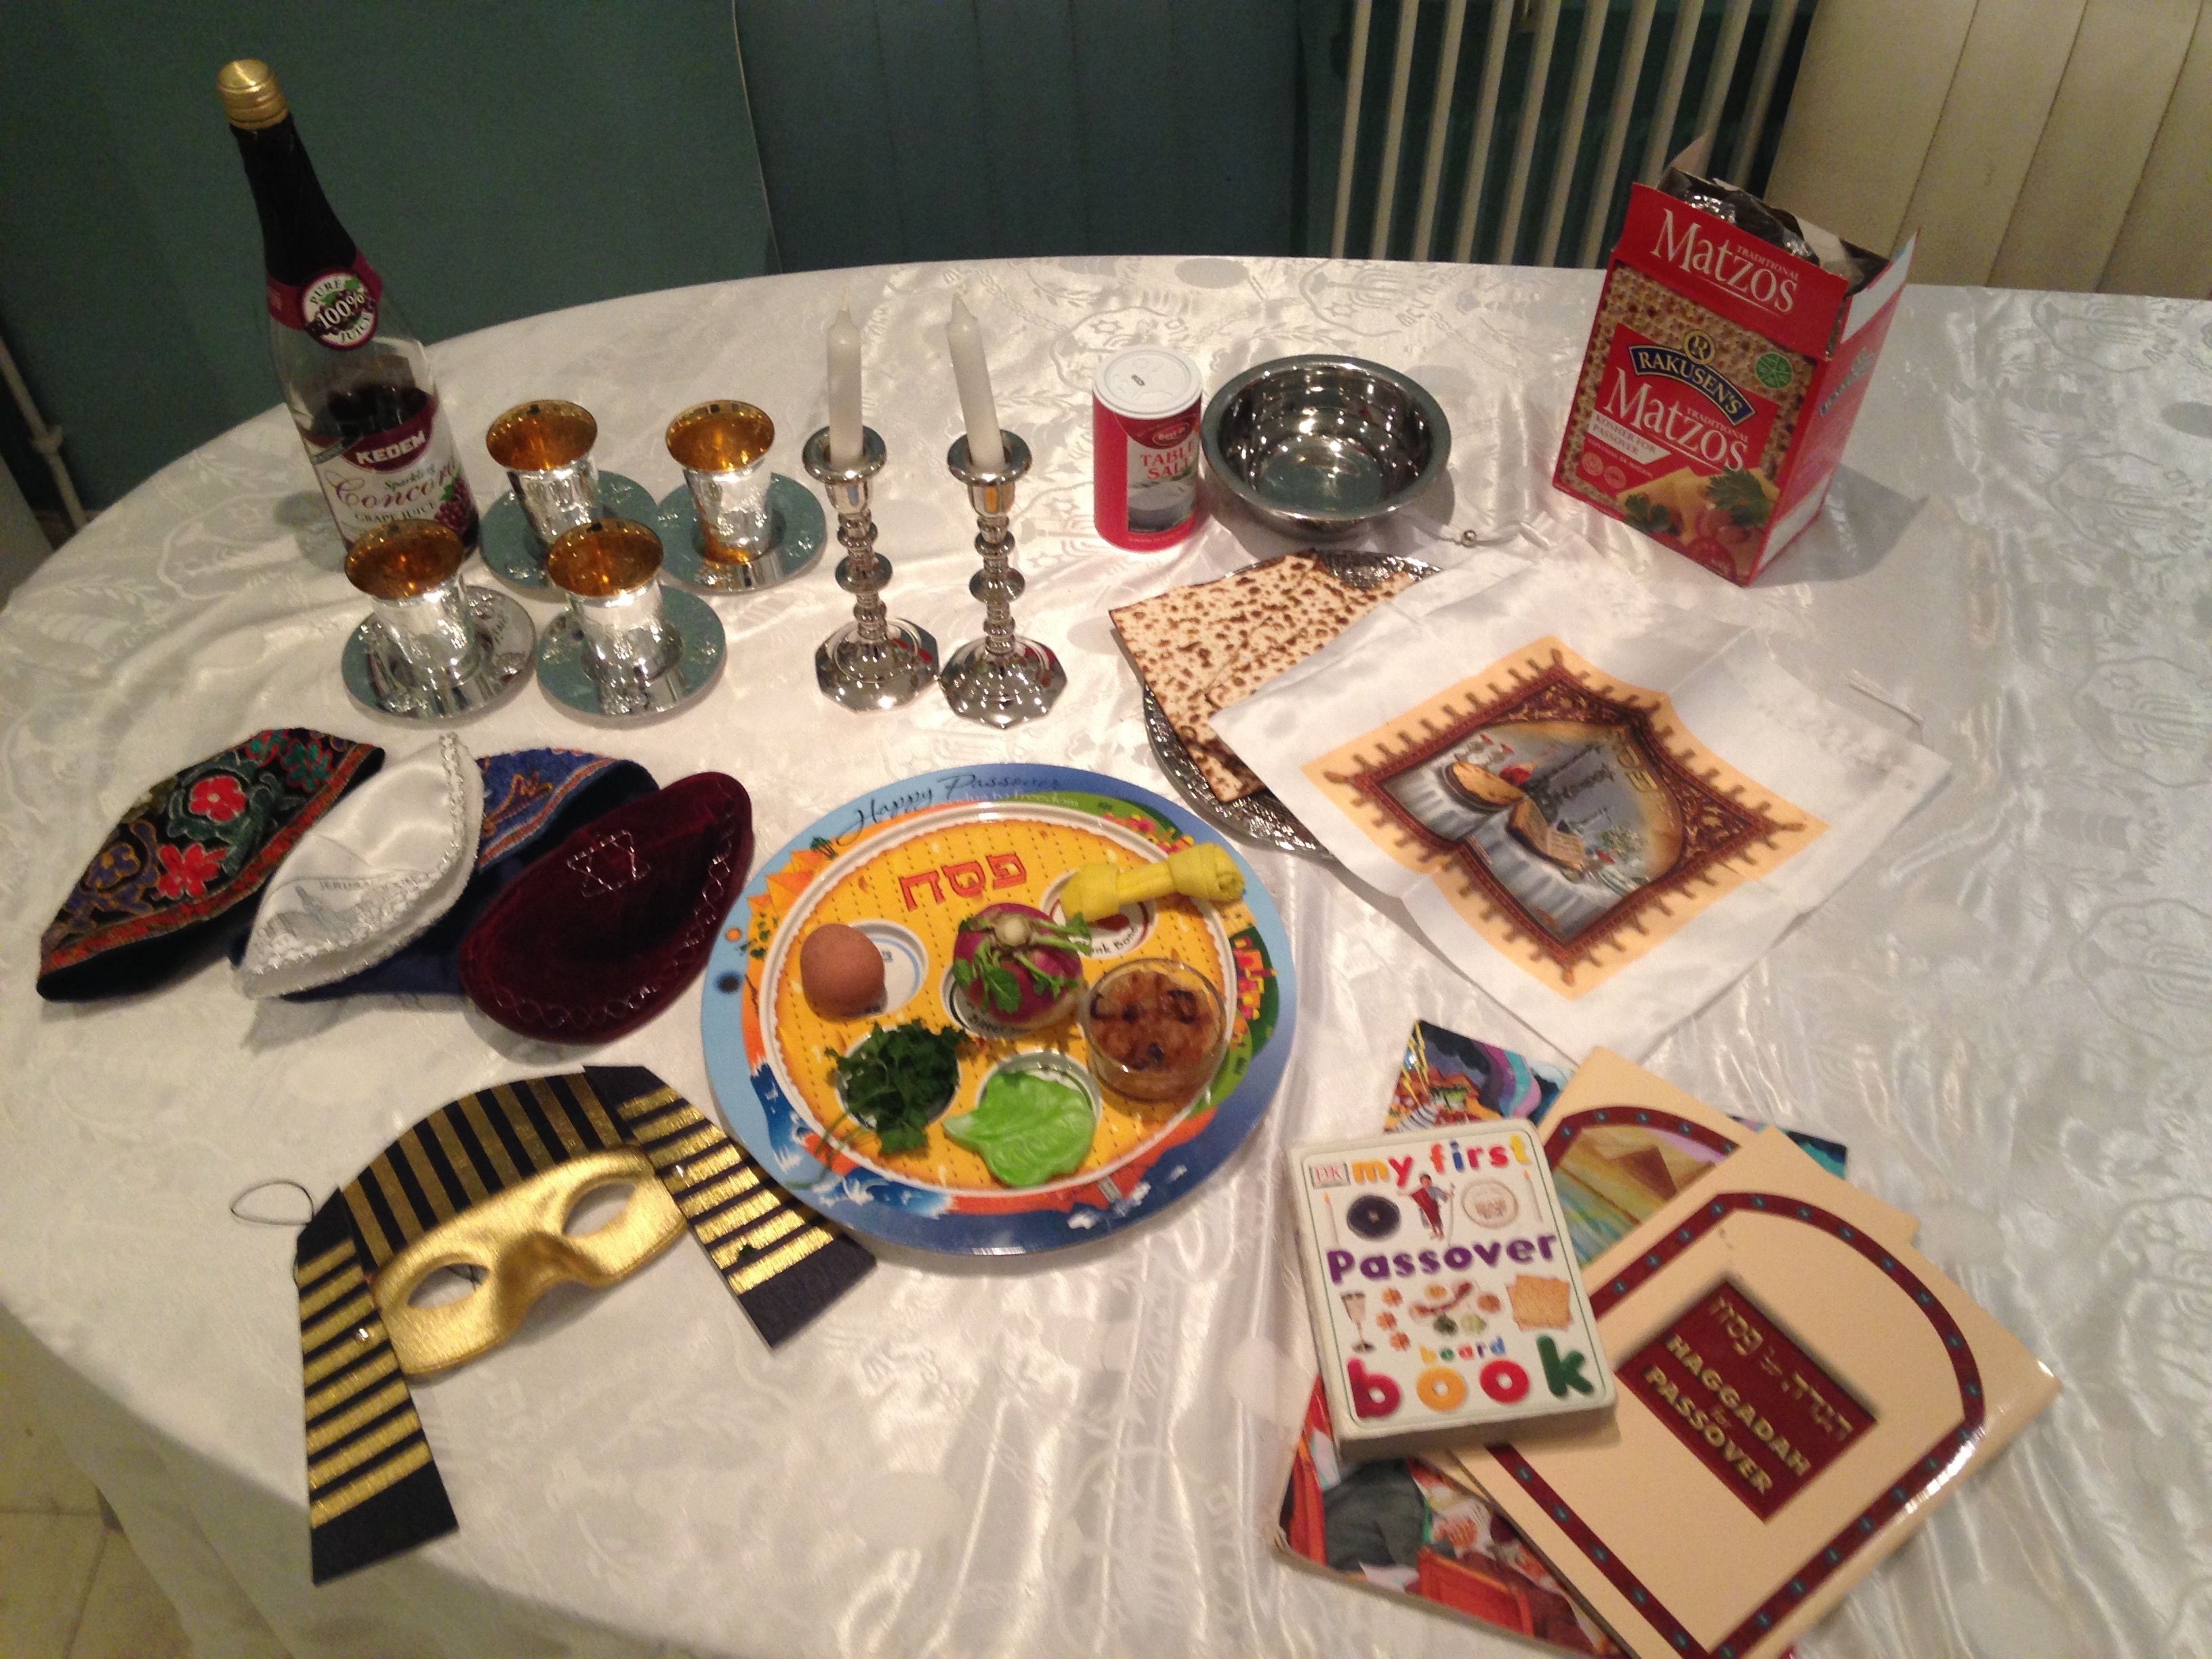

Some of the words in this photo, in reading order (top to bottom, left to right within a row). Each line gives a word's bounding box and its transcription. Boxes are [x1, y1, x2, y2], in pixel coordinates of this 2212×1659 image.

[1650, 207, 1798, 314] Matzos
[316, 293, 365, 329] 100%
[1637, 350, 1743, 415] RAKUSEN'S
[355, 430, 426, 465] KEDEM
[1603, 366, 1748, 472] Matzos
[836, 788, 933, 847] Happy
[898, 852, 1027, 912] פסח
[1350, 1155, 1413, 1188] my
[1429, 1133, 1532, 1174] first
[1326, 1232, 1557, 1286] Passover
[1346, 1334, 1595, 1419] book
[1418, 1336, 1507, 1366] board
[1643, 1364, 1774, 1496] PASSOVER
[1664, 1332, 1812, 1477] HAGGADAH
